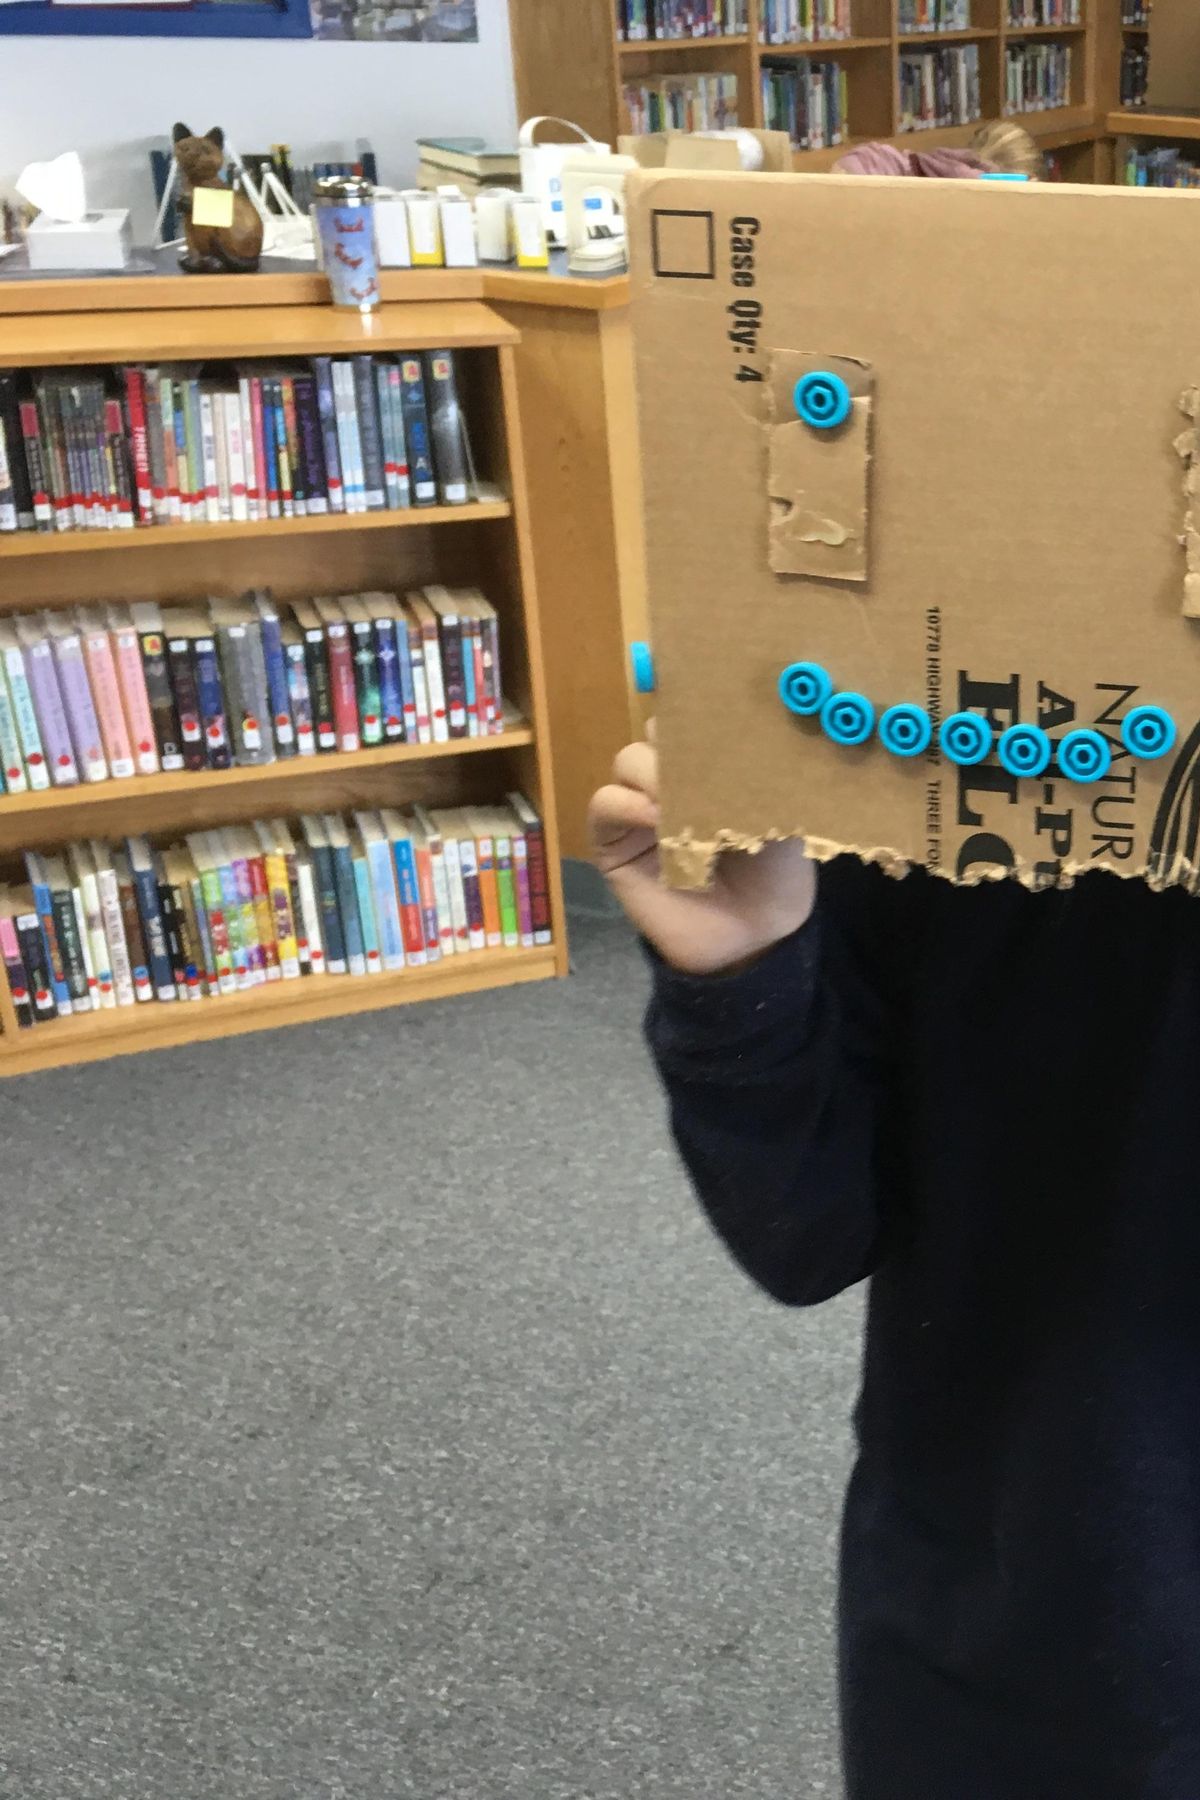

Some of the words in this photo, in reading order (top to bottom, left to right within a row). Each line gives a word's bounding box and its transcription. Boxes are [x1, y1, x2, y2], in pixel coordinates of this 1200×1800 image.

[729, 216, 761, 288] Case
[726, 300, 763, 354] Qty:
[734, 364, 765, 383] 4
[926, 606, 942, 652] 10778
[927, 780, 943, 833] THREE
